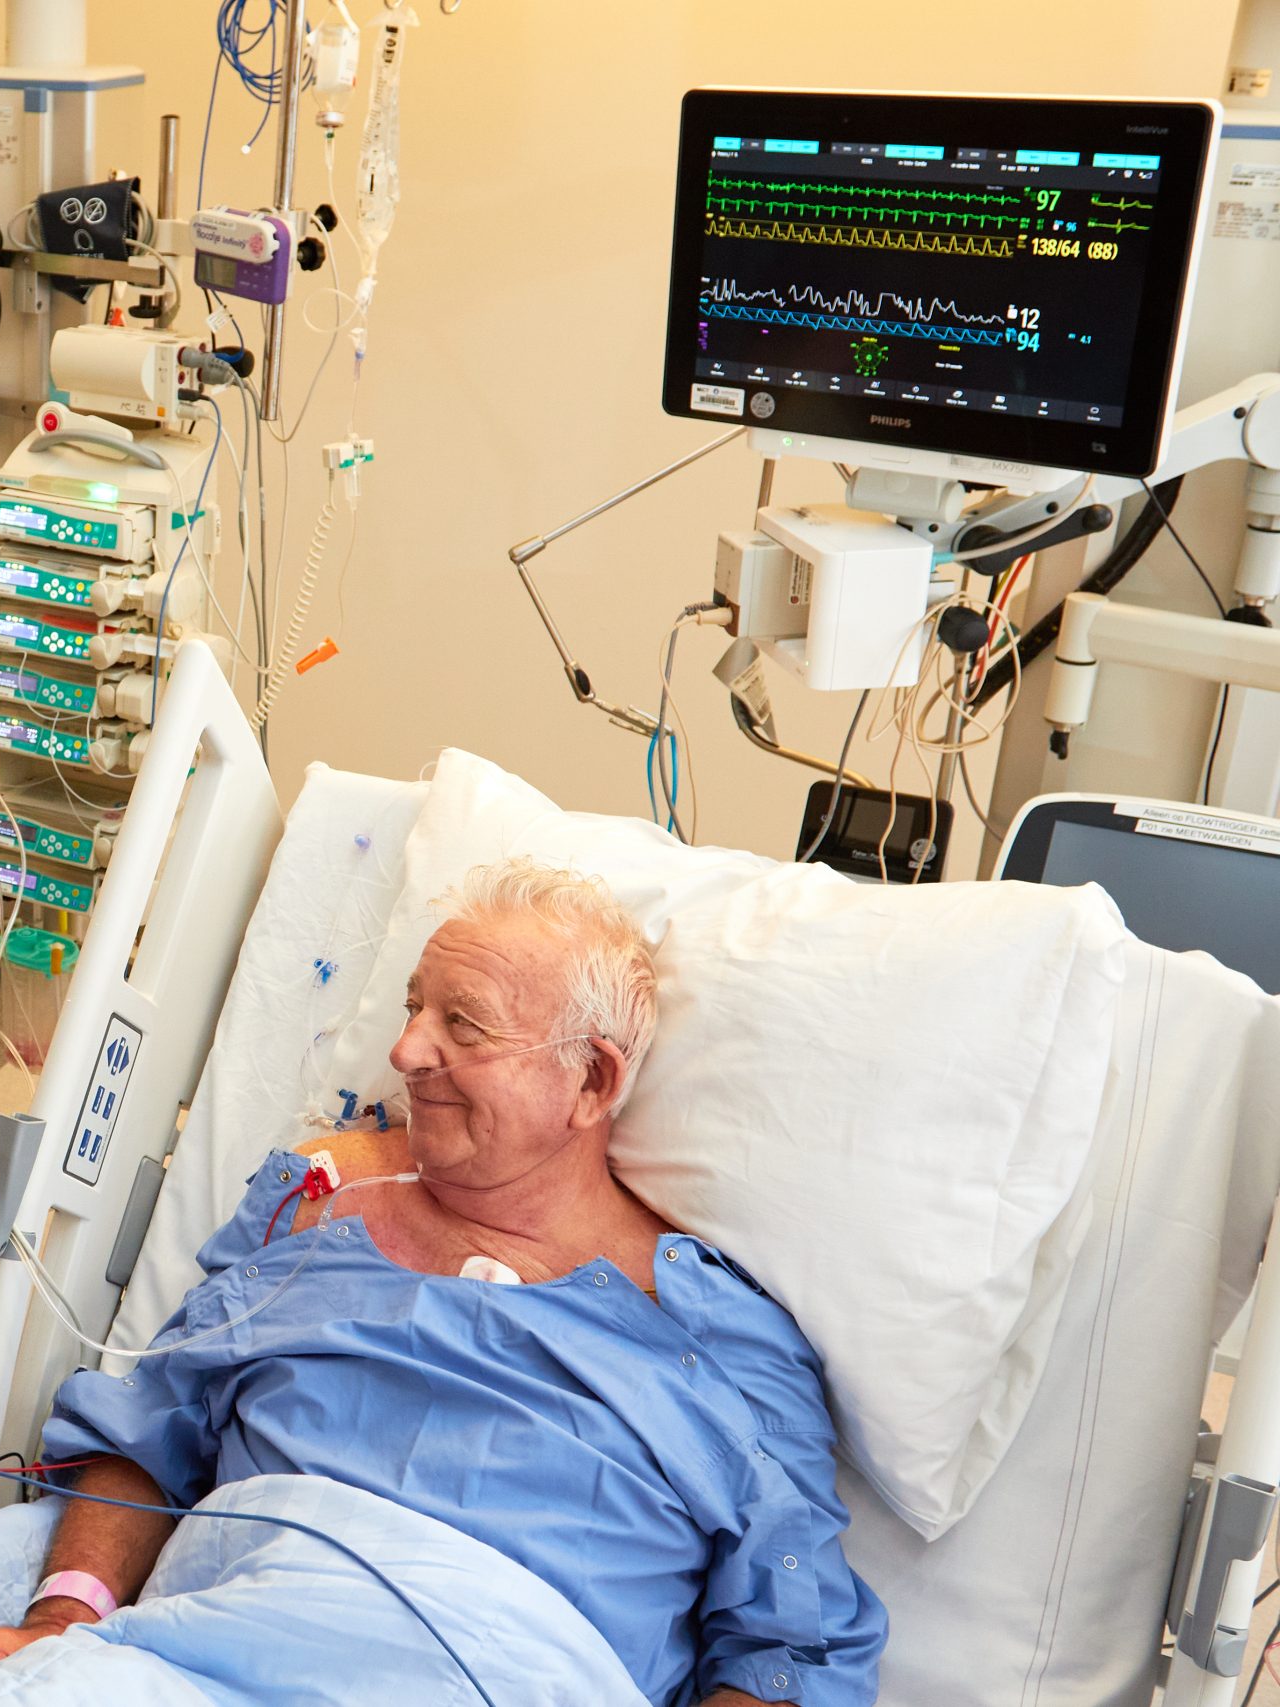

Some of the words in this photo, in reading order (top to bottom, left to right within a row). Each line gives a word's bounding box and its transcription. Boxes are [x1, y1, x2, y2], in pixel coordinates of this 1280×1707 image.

[1036, 189, 1061, 211] 97
[1031, 237, 1081, 258] 138/64
[1087, 241, 1118, 261] (88)
[1020, 308, 1040, 329] 12
[1017, 331, 1040, 353] 94
[870, 414, 911, 428] PHILIPS
[992, 461, 1030, 475] MX750
[1172, 813, 1184, 822] op
[1185, 814, 1258, 833] FLOWTRIGGER
[1141, 822, 1158, 831] P01
[1175, 828, 1252, 846] MEETWAARDEN
